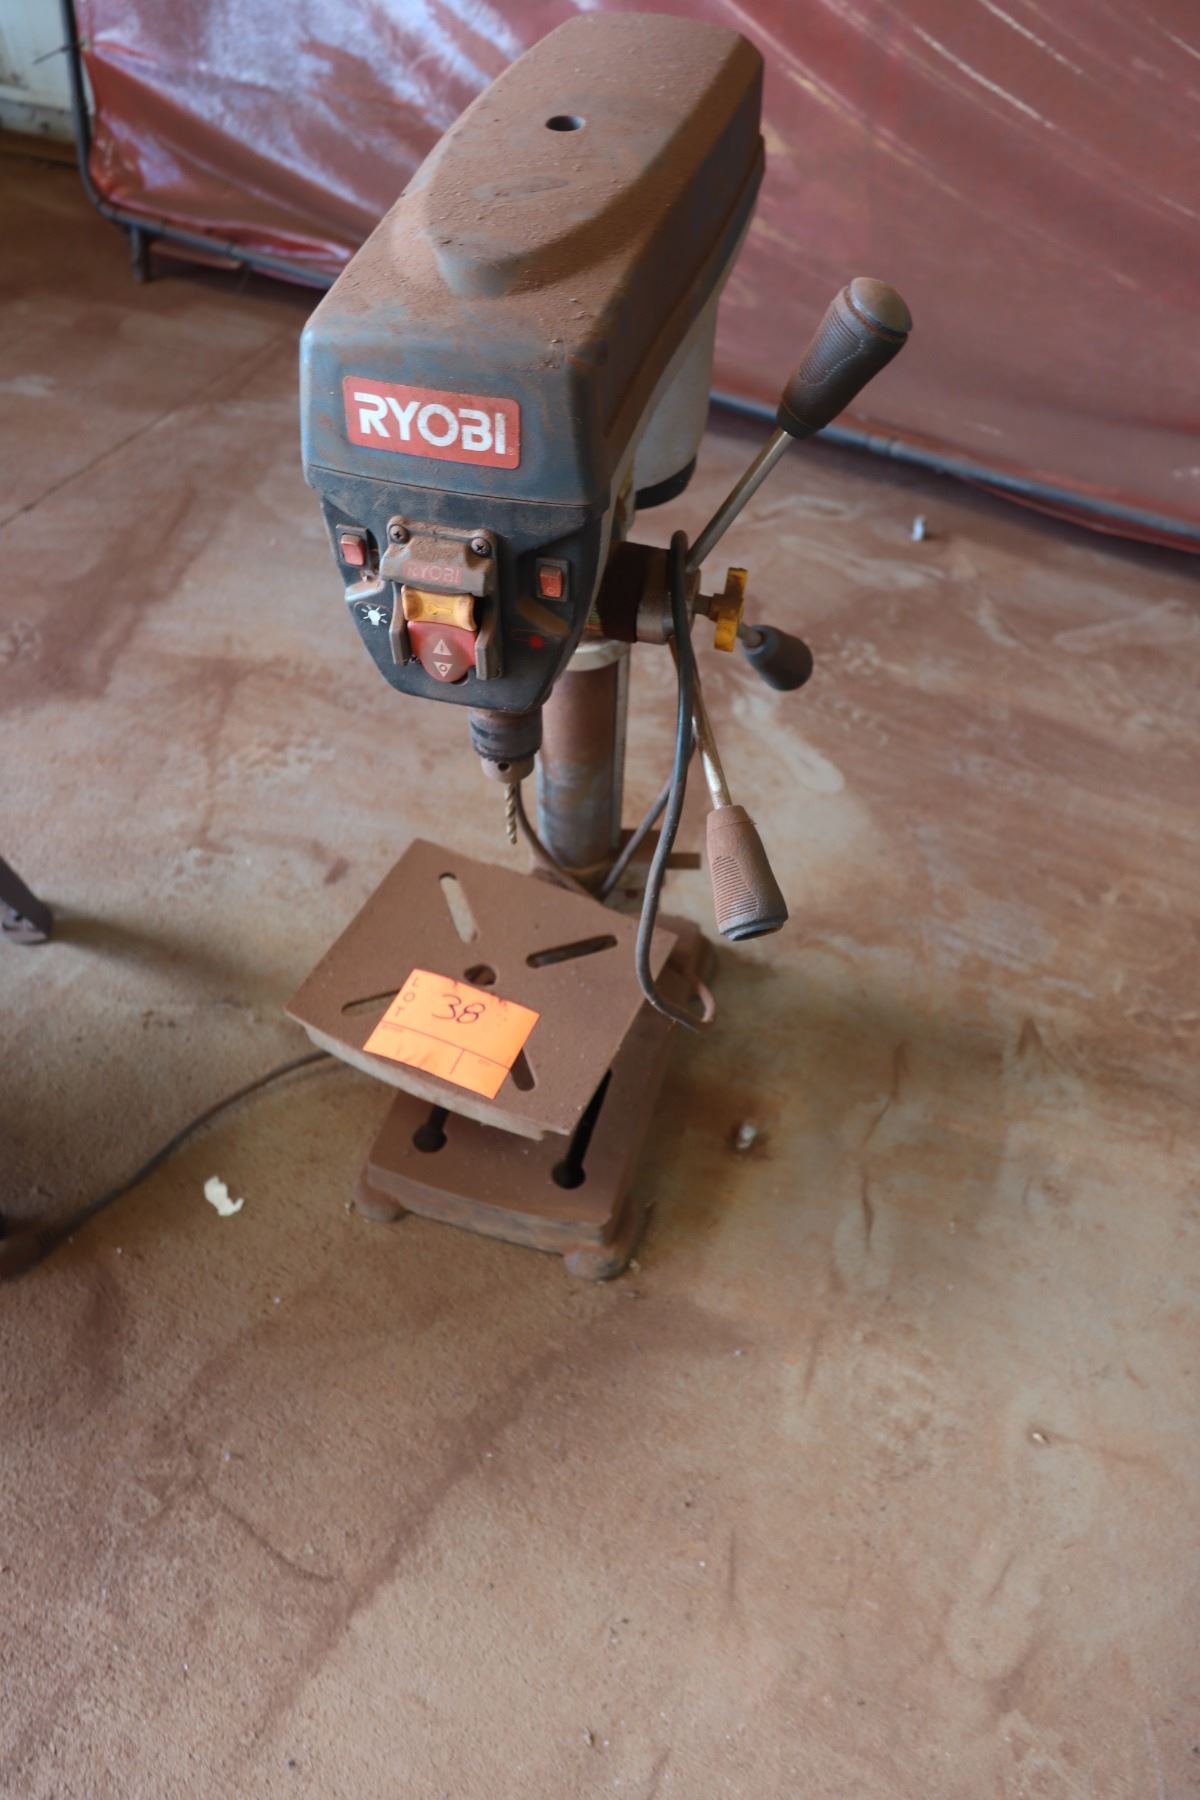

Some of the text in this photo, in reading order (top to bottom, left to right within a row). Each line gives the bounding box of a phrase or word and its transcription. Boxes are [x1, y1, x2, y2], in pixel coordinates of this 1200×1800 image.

[354, 391, 506, 455] RYOBI
[405, 562, 462, 585] RYOBI
[431, 993, 487, 1025] 38
